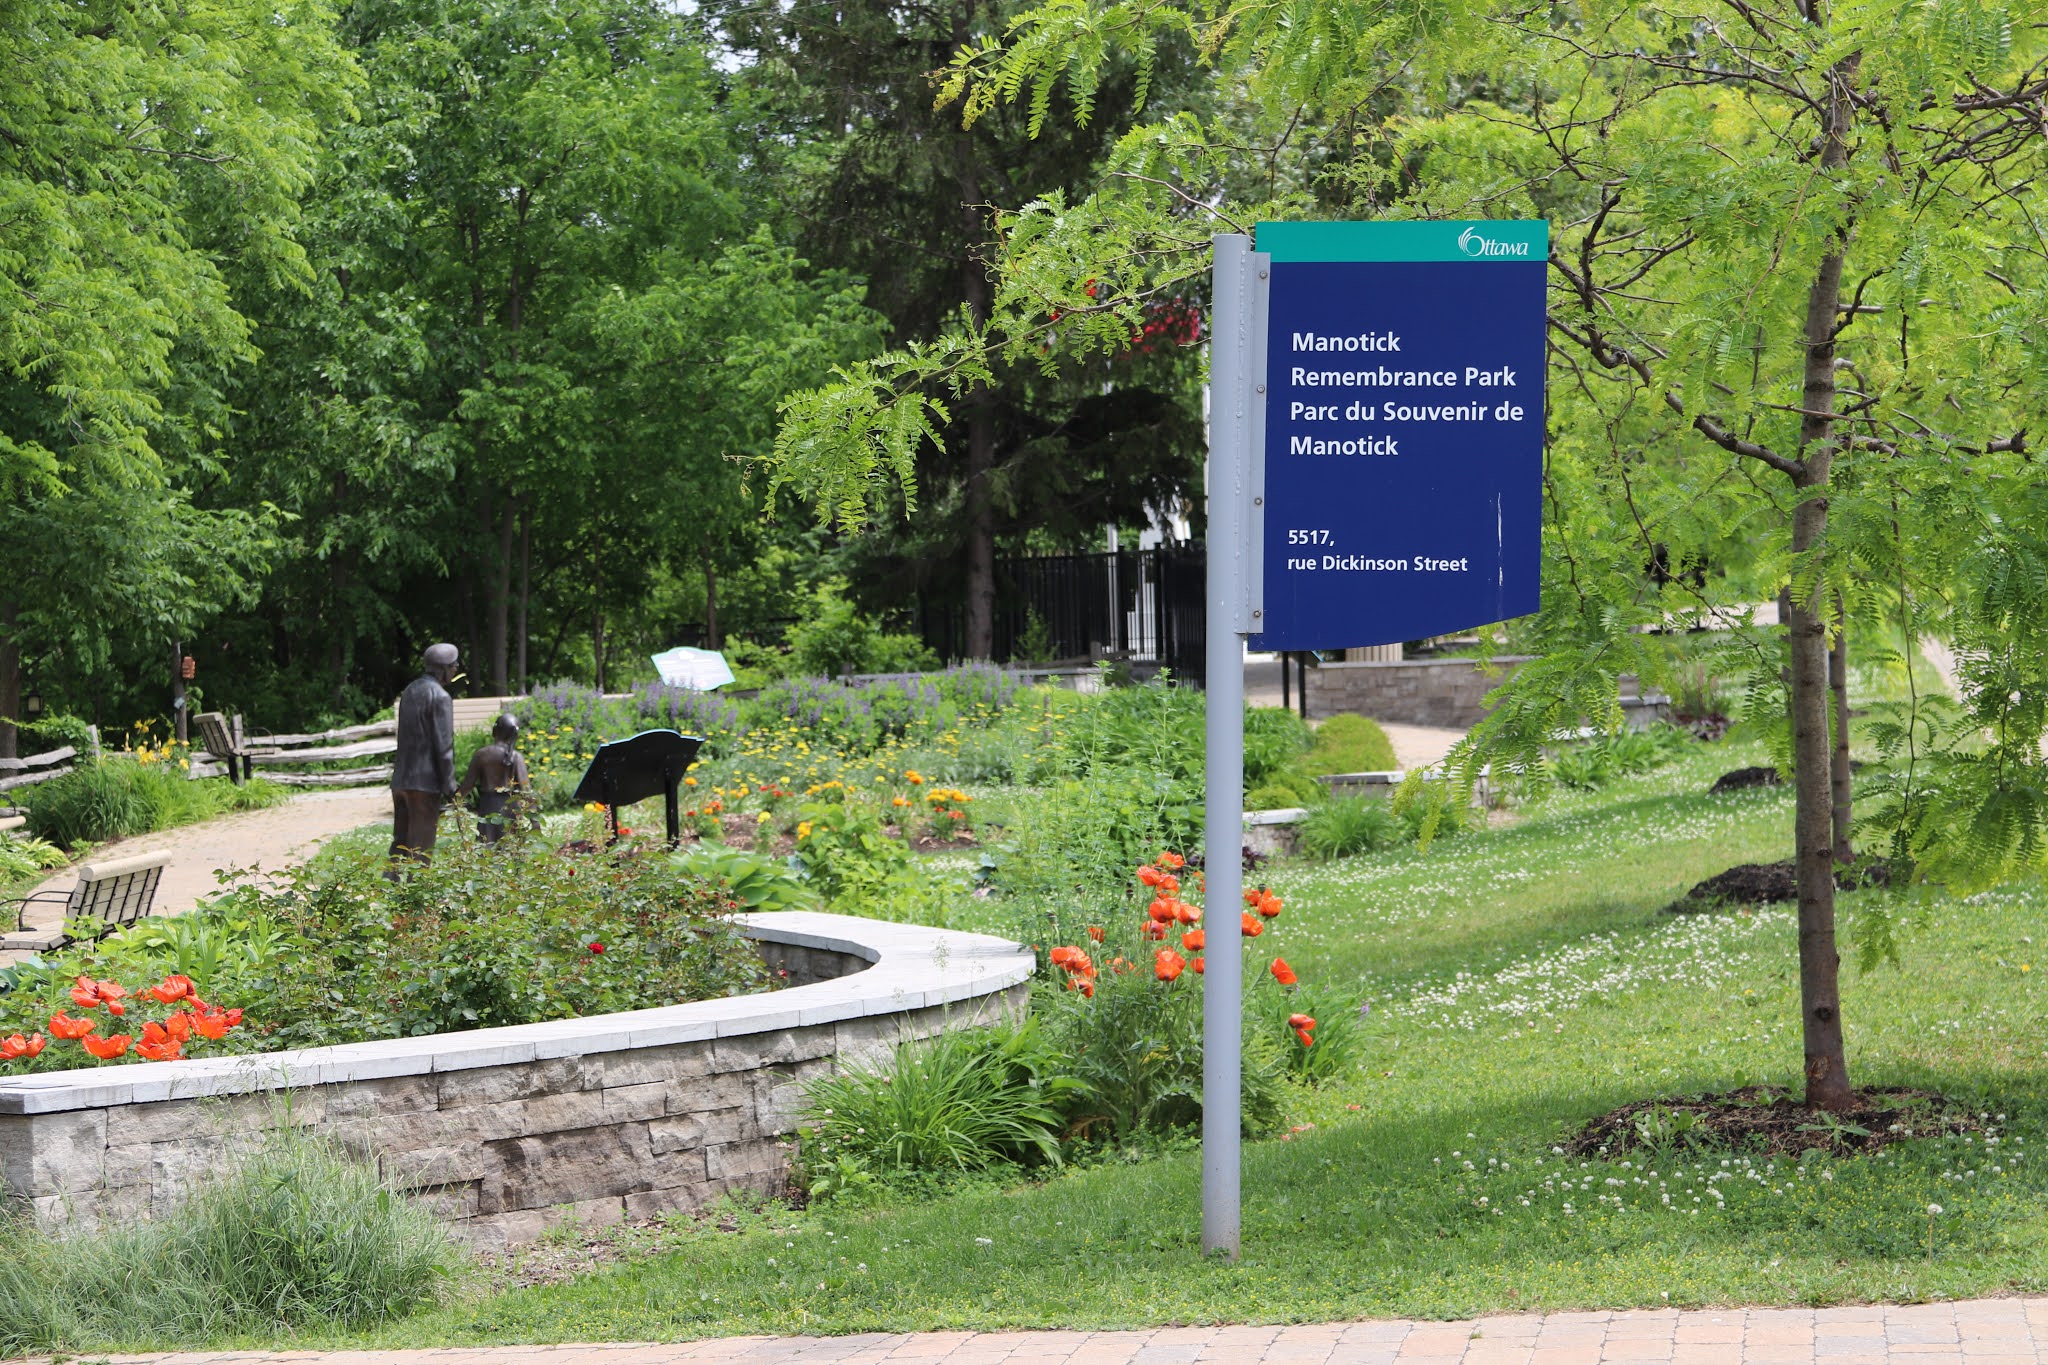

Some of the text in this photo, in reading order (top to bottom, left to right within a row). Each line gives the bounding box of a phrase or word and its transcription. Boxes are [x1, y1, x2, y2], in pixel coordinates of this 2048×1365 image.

[1458, 229, 1529, 257] Ottawa
[1292, 331, 1401, 352] Manotick
[1291, 366, 1517, 387] Remembrance Park
[1290, 400, 1524, 421] Parc du Souvenir de
[1290, 435, 1399, 456] Manotick
[1288, 529, 1335, 547] 5517,
[1287, 555, 1468, 572] rue Dickinson Street
